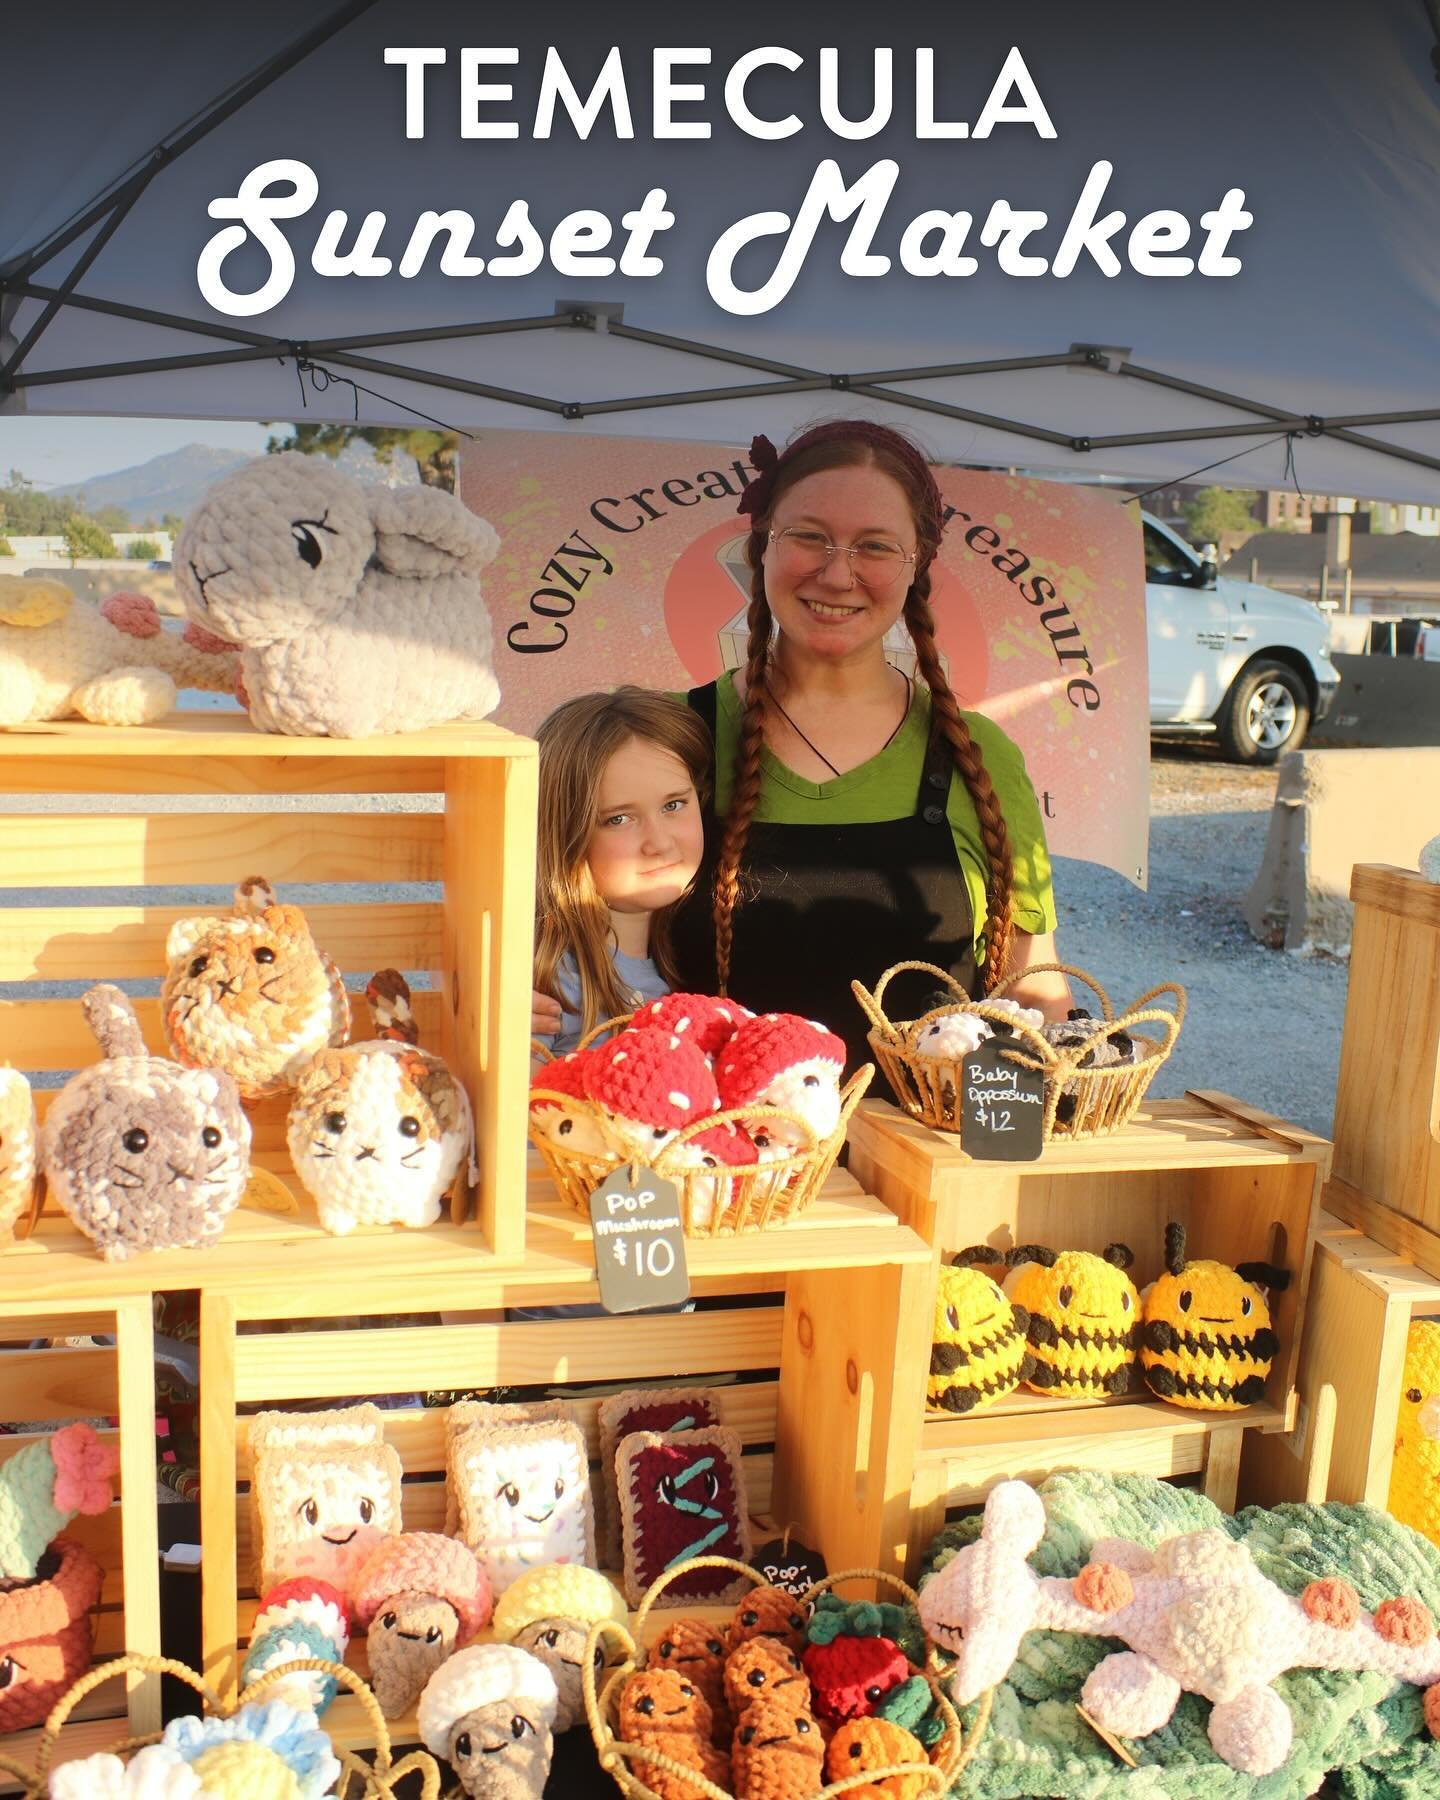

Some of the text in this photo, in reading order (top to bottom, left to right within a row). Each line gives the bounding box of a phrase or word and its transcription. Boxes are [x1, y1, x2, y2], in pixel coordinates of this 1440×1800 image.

[507, 461, 1101, 711] Cozy Creat reasure
[968, 1065, 1018, 1089] Baby
[975, 1108, 1016, 1132] $12
[613, 1238, 675, 1277] $10
